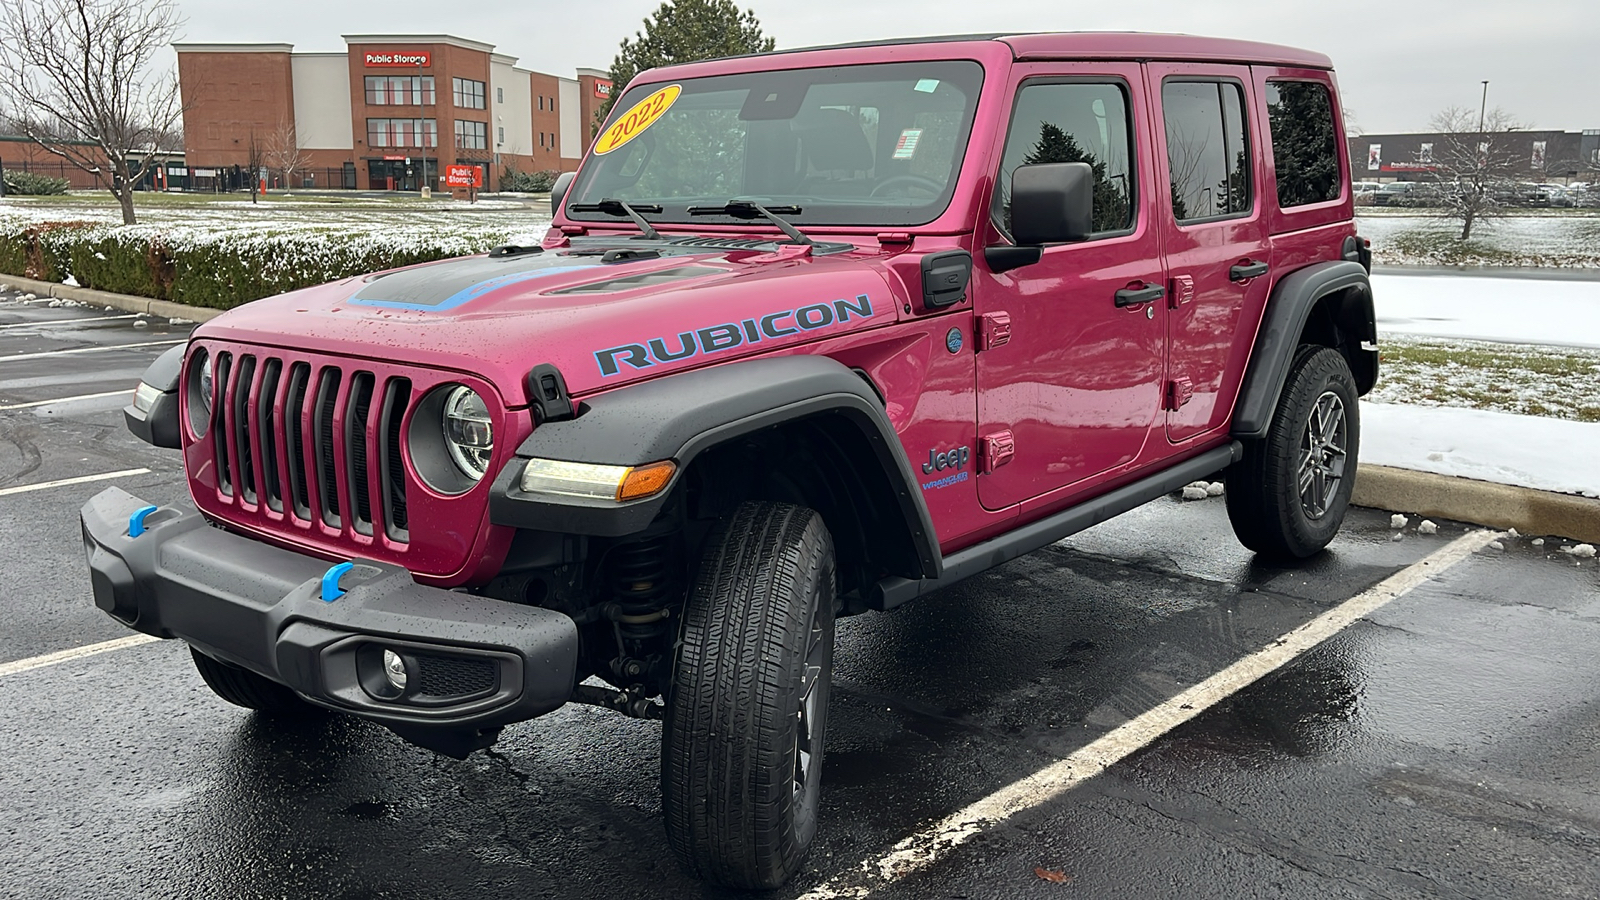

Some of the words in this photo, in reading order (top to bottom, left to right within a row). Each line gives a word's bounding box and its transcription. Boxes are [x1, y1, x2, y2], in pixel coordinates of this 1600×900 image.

[366, 54, 392, 64] Public
[393, 54, 427, 65] Storage
[609, 92, 666, 148] 2022
[451, 167, 472, 176] Public
[593, 294, 873, 377] RUBICON
[922, 445, 969, 475] Jeep
[922, 471, 968, 490] WRANGLER
